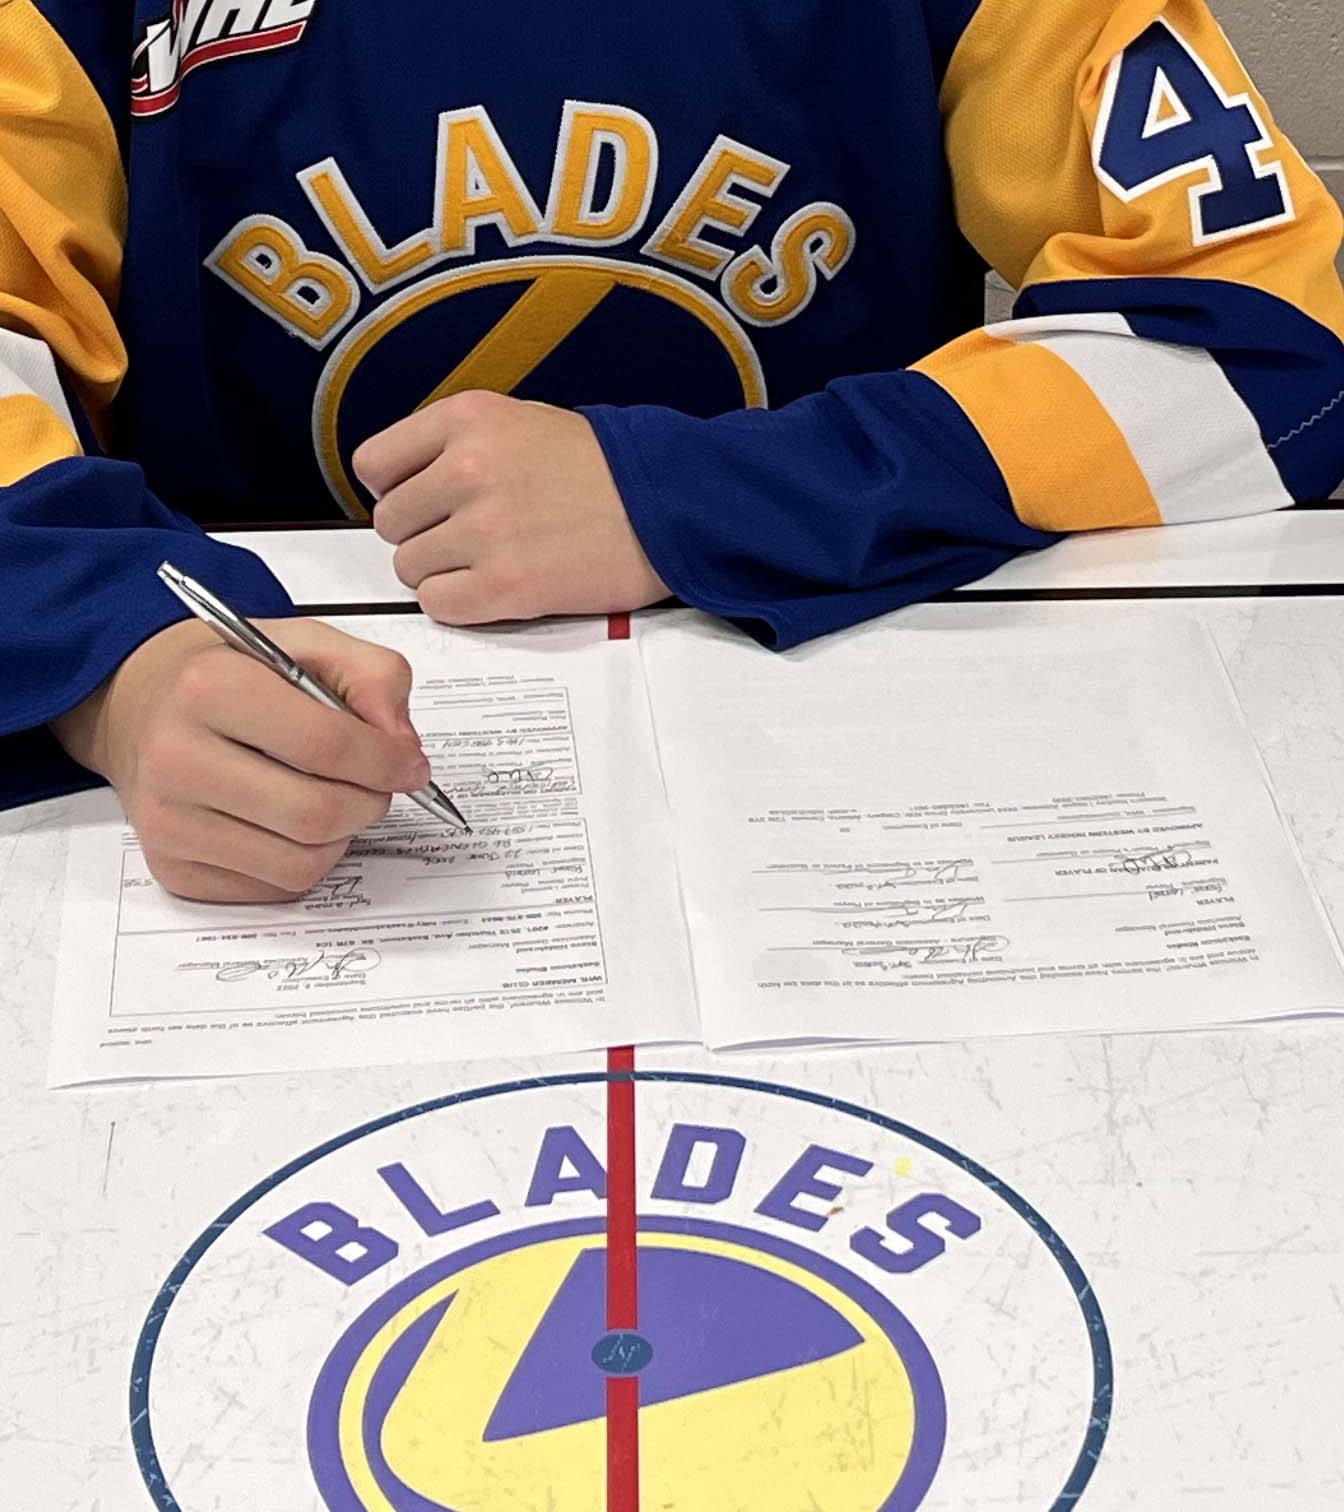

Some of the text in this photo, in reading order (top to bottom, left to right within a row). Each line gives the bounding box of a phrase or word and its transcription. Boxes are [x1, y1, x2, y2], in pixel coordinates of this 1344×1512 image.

[203, 99, 858, 352] BLADES
[1092, 15, 1296, 248] 4
[261, 1122, 982, 1287] BLADES
